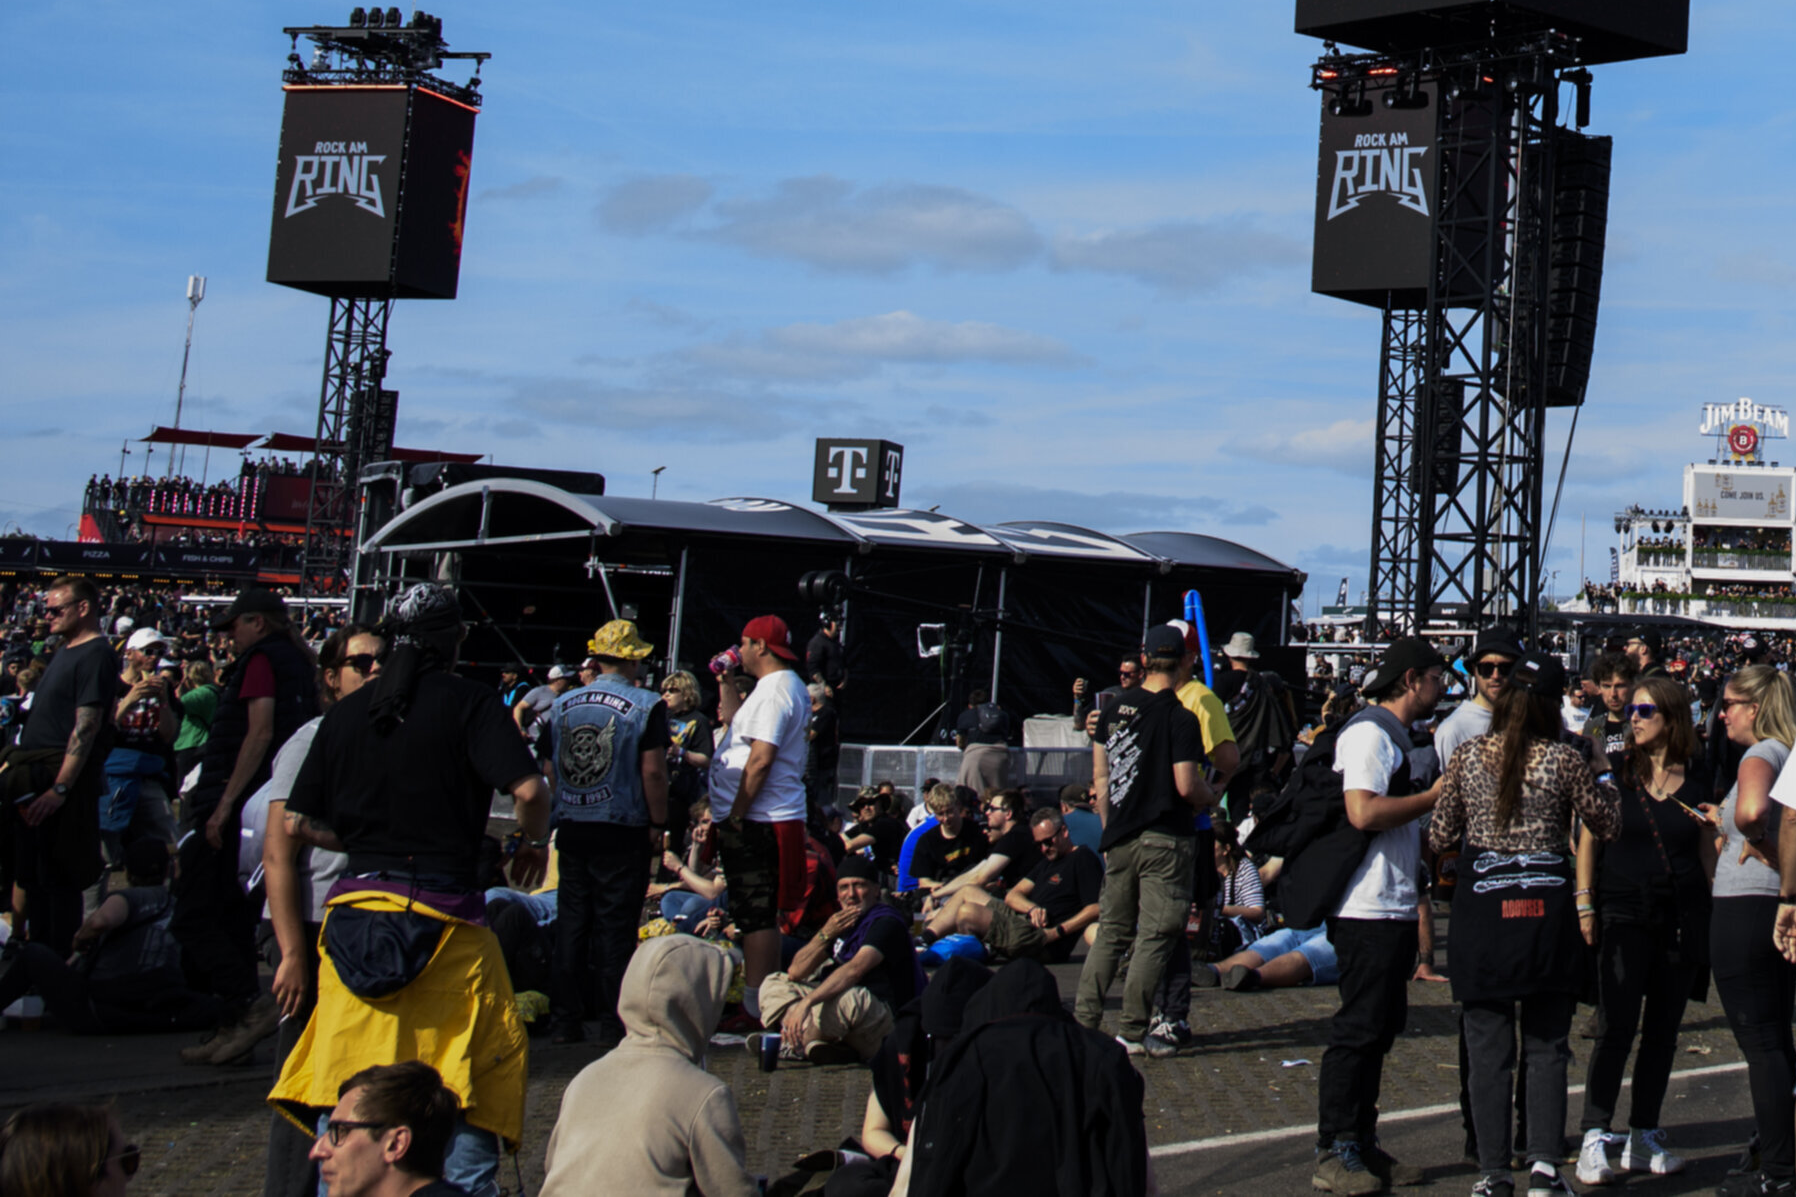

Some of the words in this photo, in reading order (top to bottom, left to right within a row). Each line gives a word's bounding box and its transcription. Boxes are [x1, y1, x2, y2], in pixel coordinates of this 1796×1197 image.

[314, 141, 346, 154] ROCK
[348, 140, 368, 154] AM
[1354, 133, 1387, 148] ROCK
[1389, 132, 1408, 146] AM
[284, 154, 388, 220] RING
[1326, 146, 1430, 221] RING
[1699, 402, 1736, 434] JIM
[1738, 397, 1790, 438] BEAM
[1739, 435, 1748, 446] B
[827, 446, 869, 494] T
[884, 449, 901, 499] T
[1720, 490, 1737, 500] COME
[1739, 491, 1753, 500] JOIN
[82, 550, 110, 559] PIZZA
[182, 554, 201, 563] FISH
[202, 554, 208, 563] &
[209, 555, 234, 564] CHIPS
[567, 694, 588, 707] ROCK
[589, 693, 602, 702] AM
[603, 696, 626, 711] RING
[561, 791, 582, 805] SINCE
[586, 789, 608, 804] 1993
